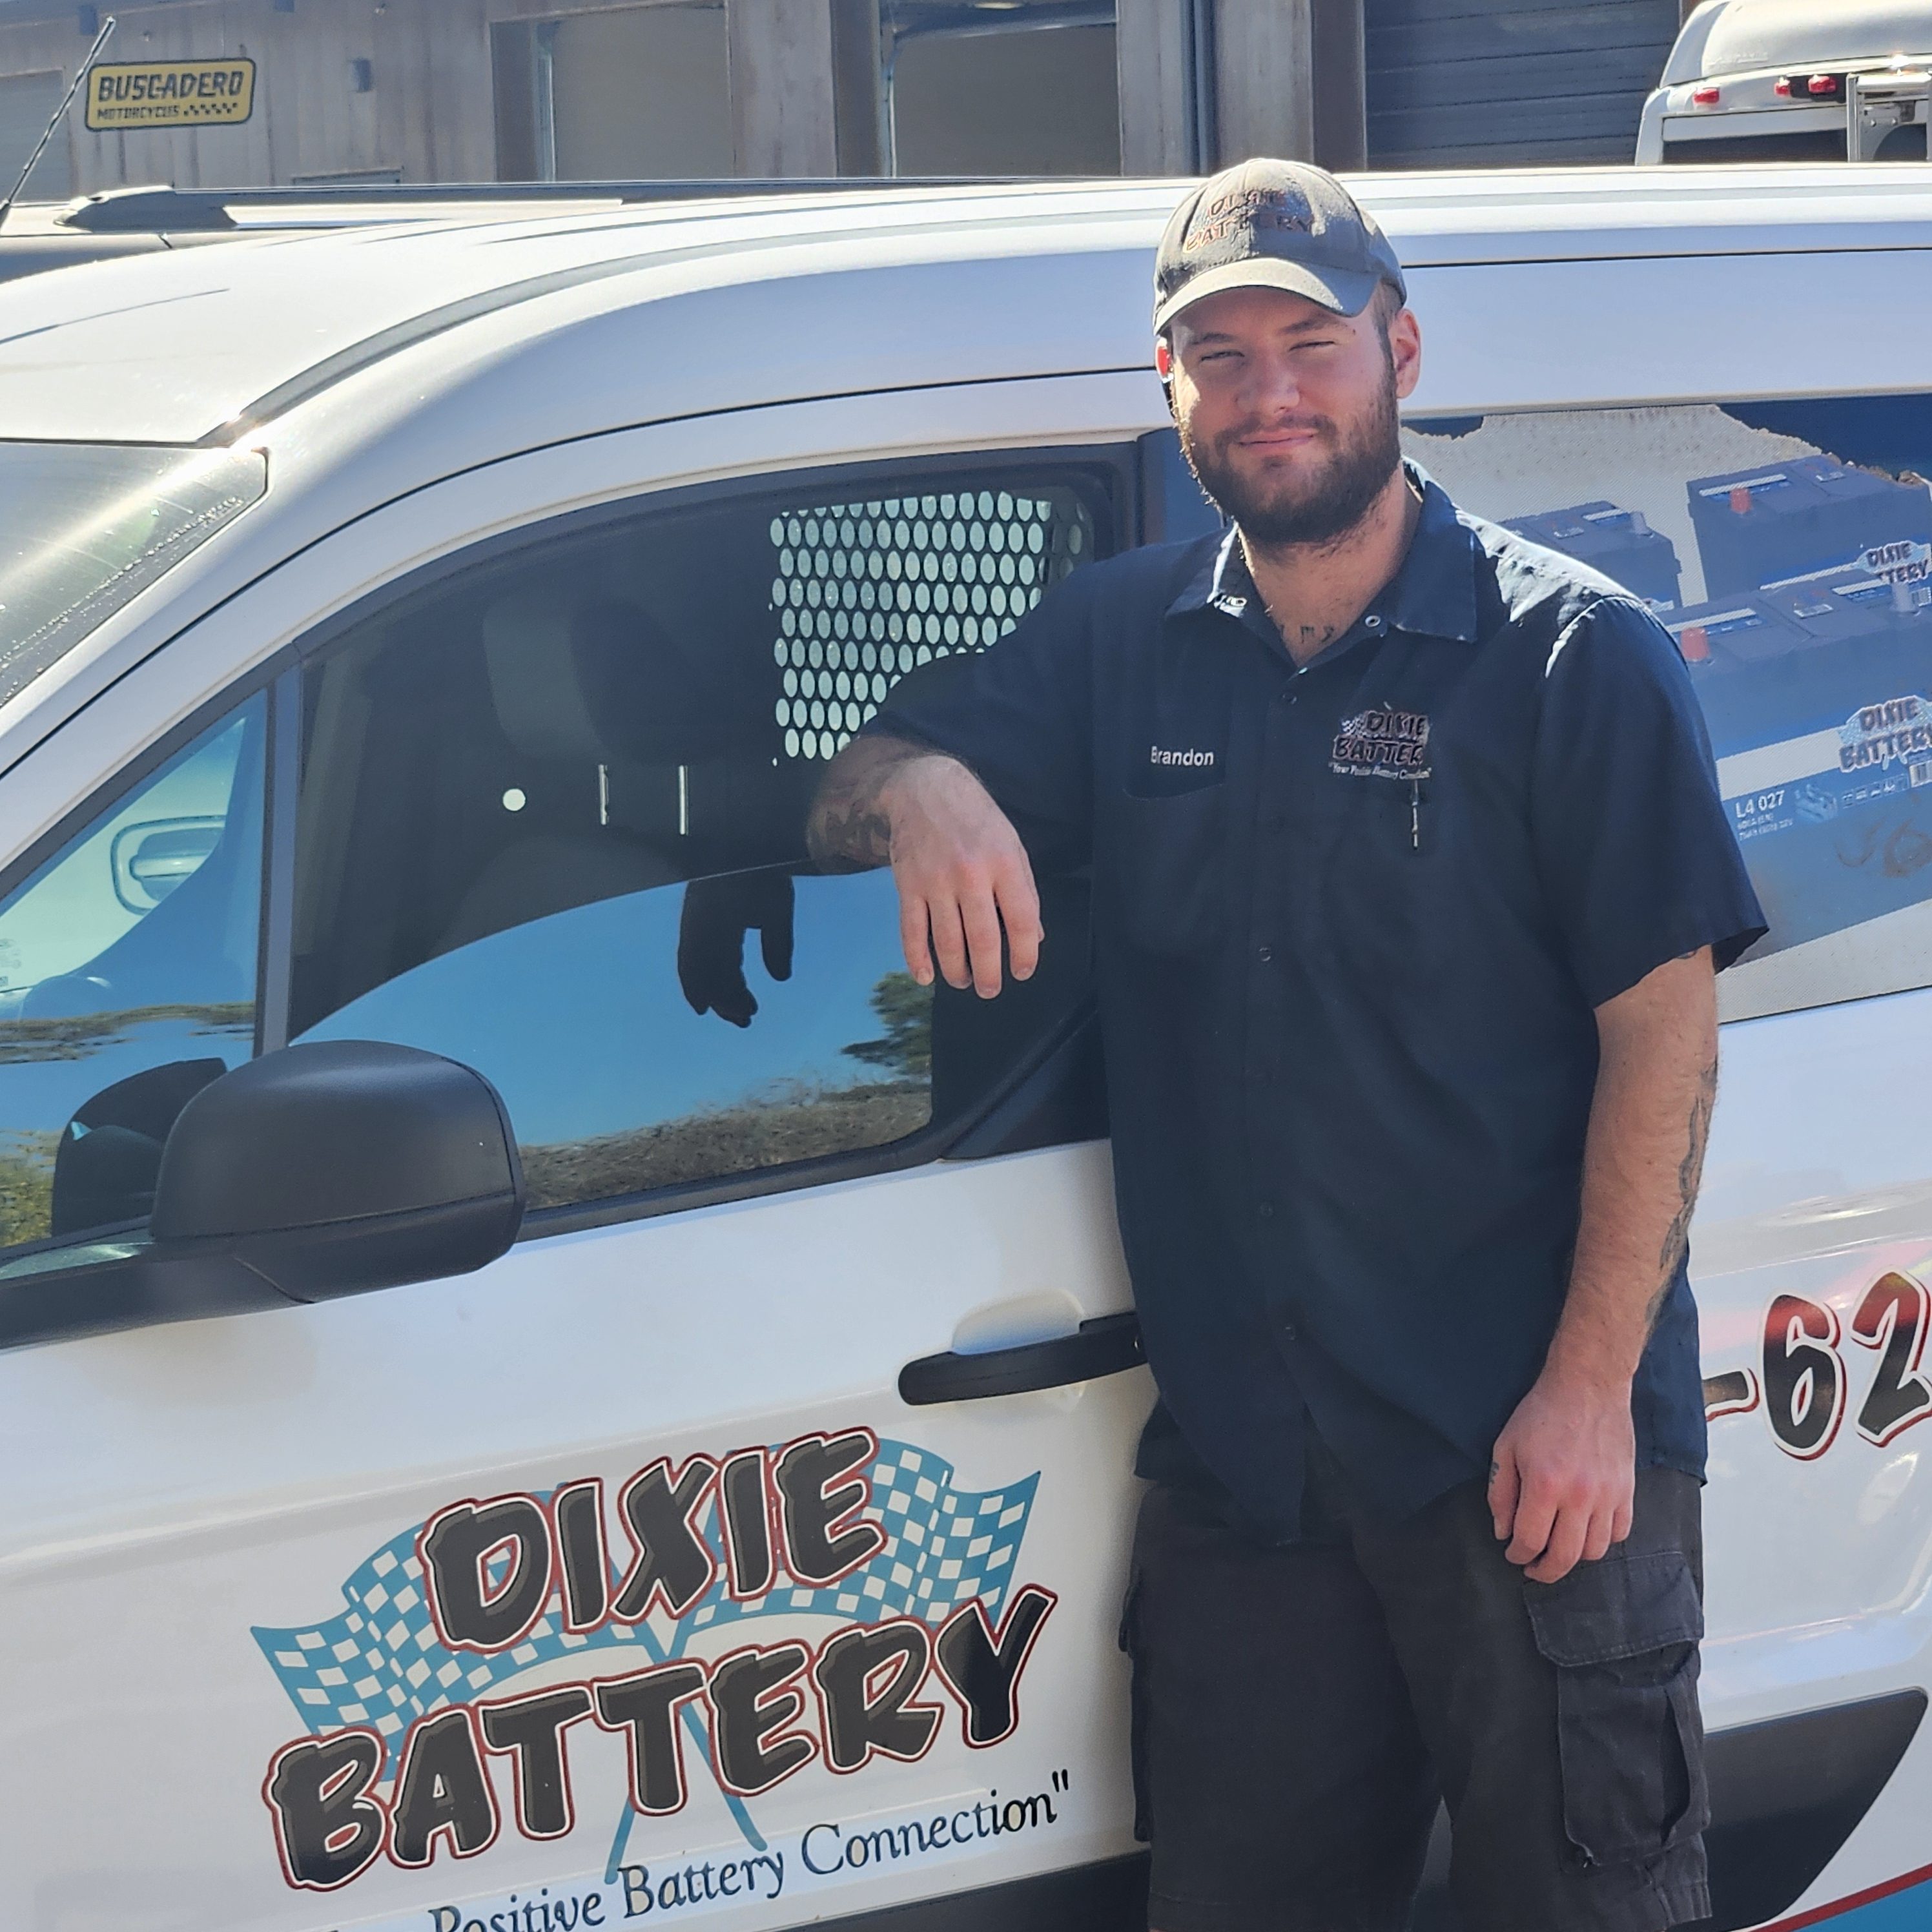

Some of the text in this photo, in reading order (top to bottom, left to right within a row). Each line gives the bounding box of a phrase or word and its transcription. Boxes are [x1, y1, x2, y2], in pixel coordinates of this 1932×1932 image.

[98, 71, 244, 102] BUSCADERO
[1365, 711, 1428, 736] DIXIE
[1150, 745, 1214, 766] Brandon
[1758, 790, 1785, 811] 027
[415, 1426, 888, 1653] DIXIE
[262, 1585, 1058, 1893] BATTERY
[617, 1851, 784, 1919] Battery
[801, 1769, 1069, 1875] Connection"
